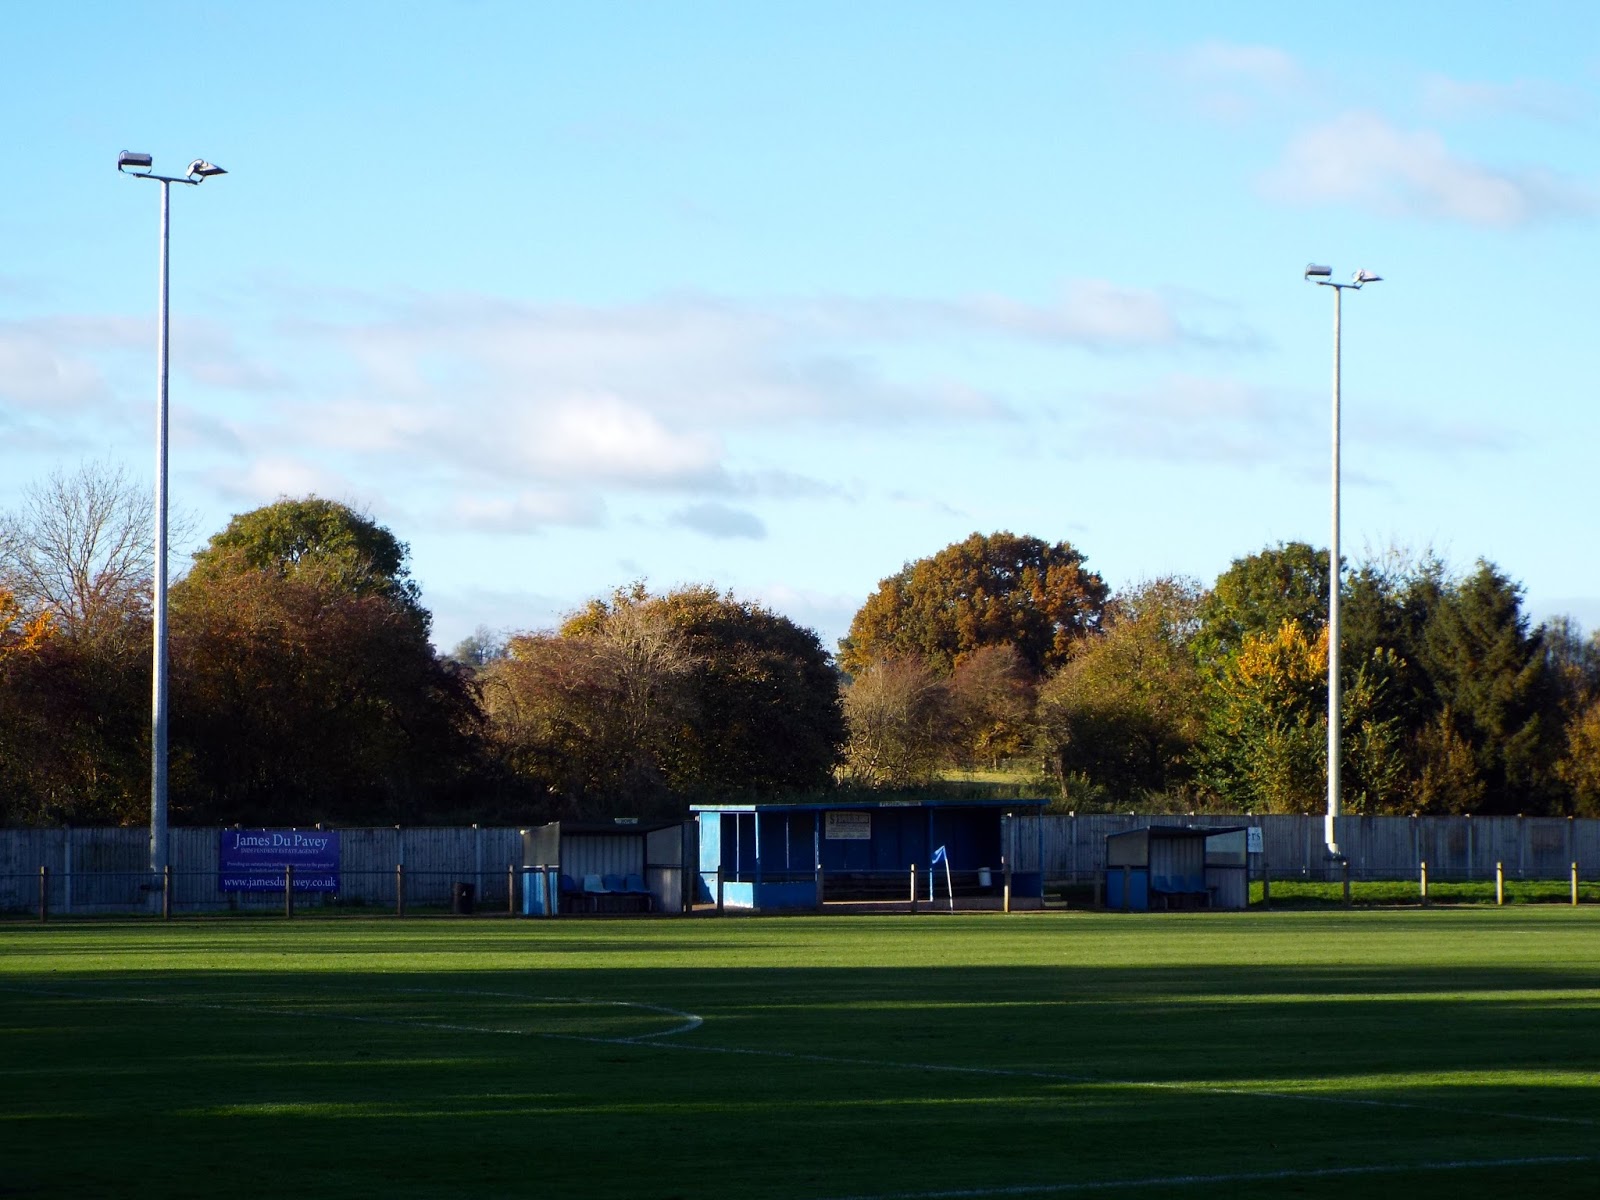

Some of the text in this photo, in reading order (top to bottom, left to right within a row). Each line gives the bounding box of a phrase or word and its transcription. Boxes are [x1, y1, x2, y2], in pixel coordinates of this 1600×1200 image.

[233, 833, 328, 851] James Du Pavey
[224, 876, 336, 889] www.jamesduvey.co.uk
